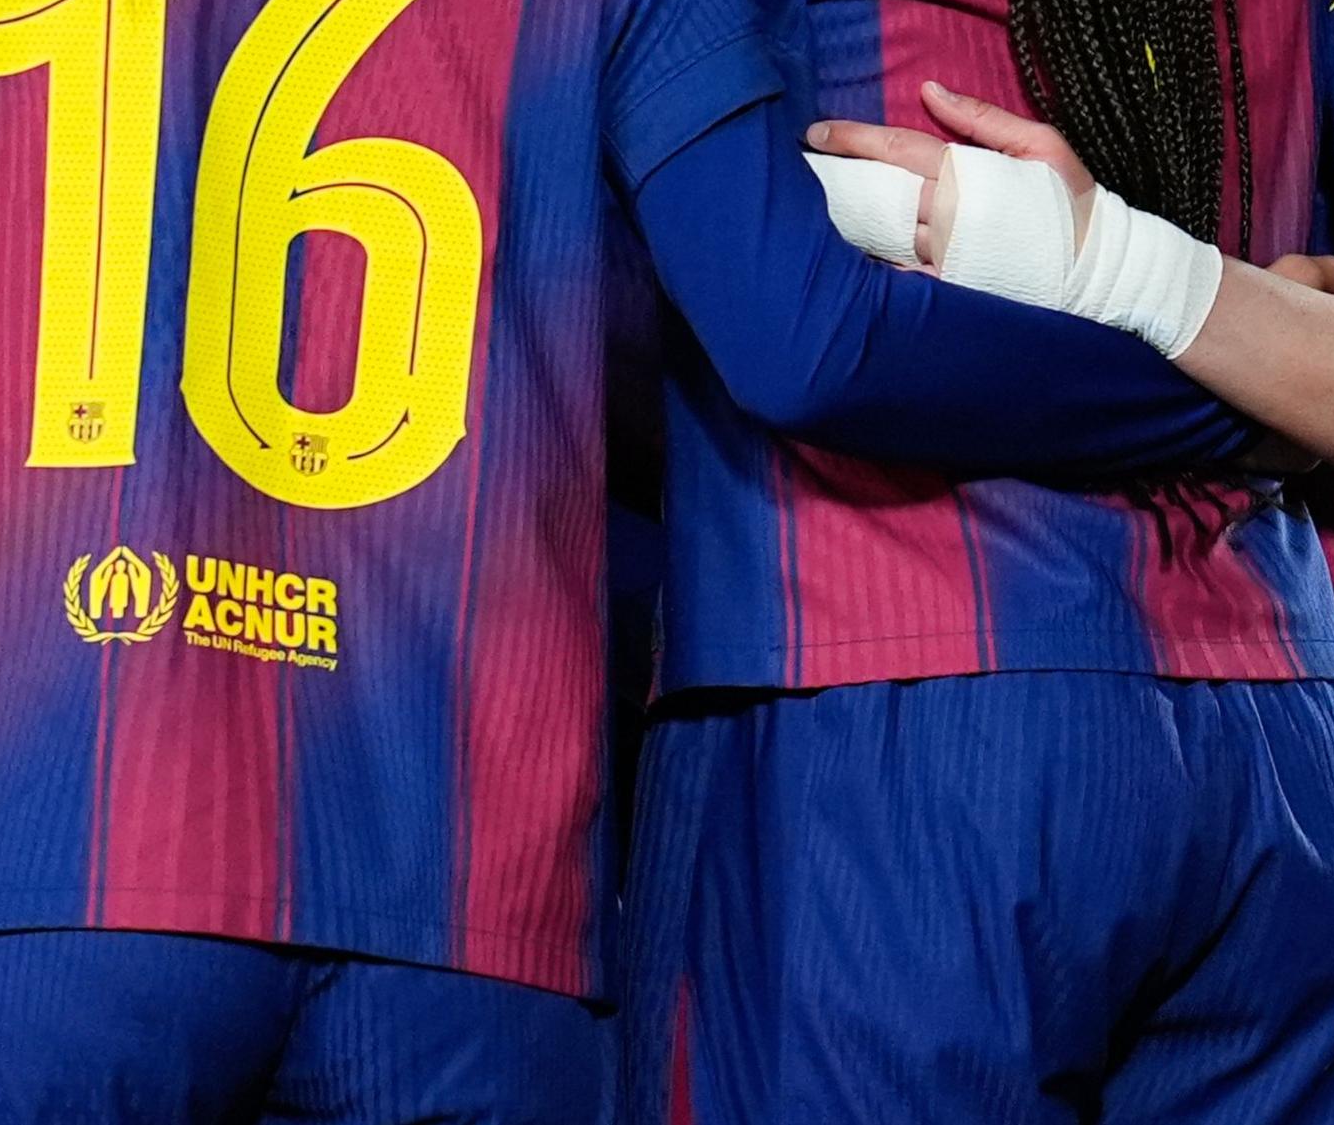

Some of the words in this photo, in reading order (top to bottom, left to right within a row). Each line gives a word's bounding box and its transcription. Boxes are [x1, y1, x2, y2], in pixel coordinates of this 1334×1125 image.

[185, 554, 338, 616] UNHCR
[182, 594, 338, 653] ACNUR
[184, 630, 210, 645] The
[212, 635, 232, 650] UN
[233, 640, 286, 661] Refugee
[287, 649, 338, 672] Agency
